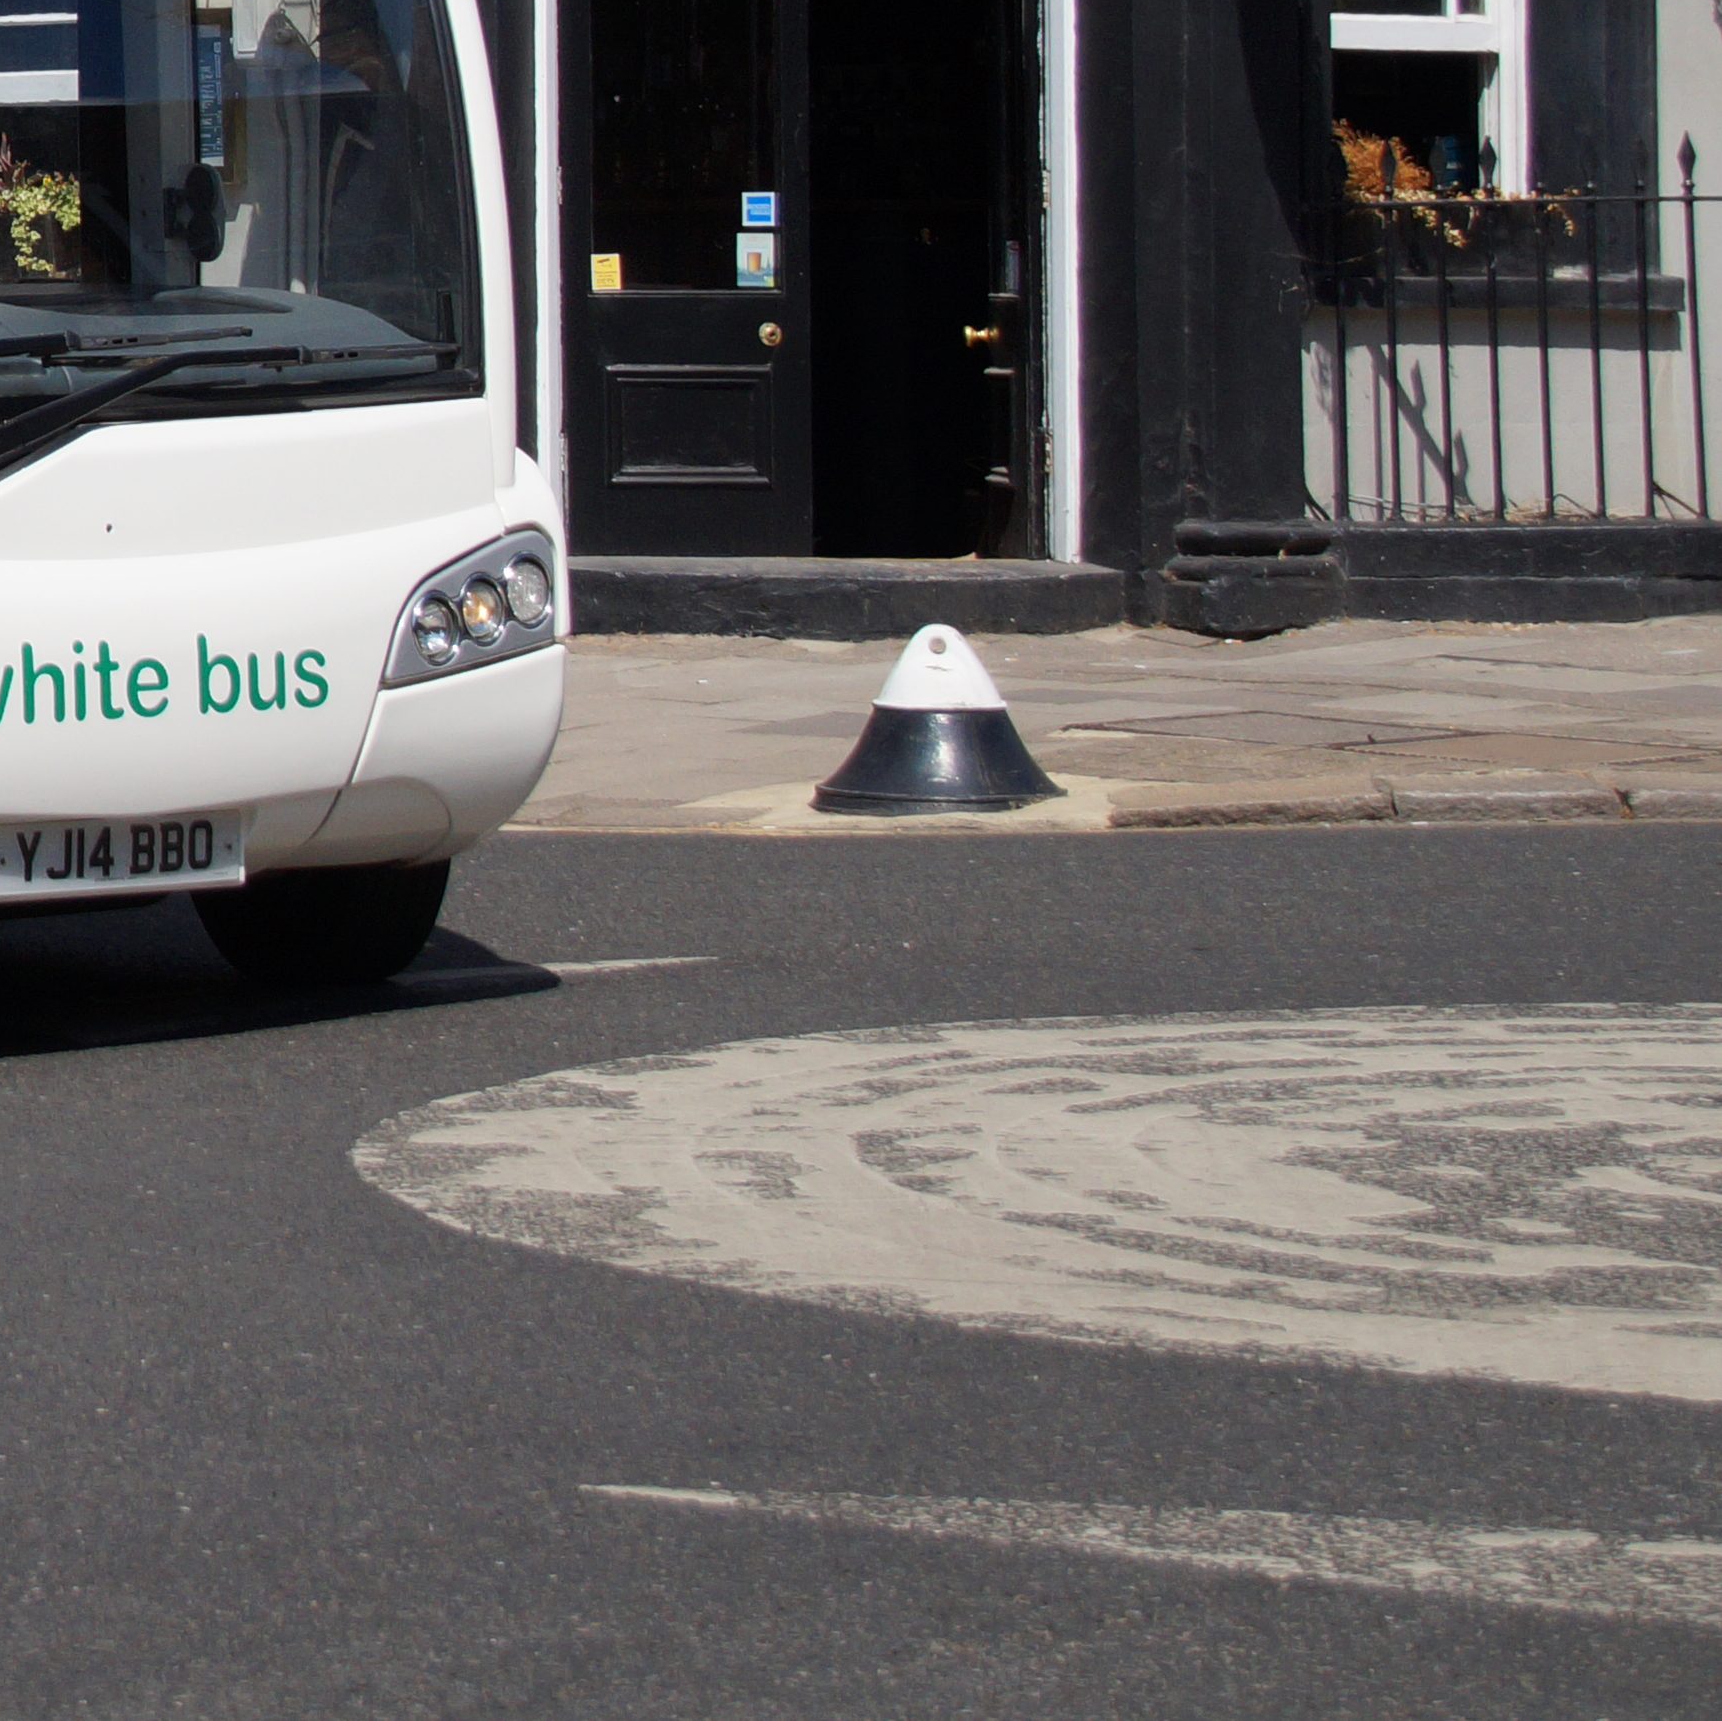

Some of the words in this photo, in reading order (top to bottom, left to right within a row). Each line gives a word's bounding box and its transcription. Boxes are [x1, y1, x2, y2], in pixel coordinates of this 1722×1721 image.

[196, 632, 330, 715] bus
[16, 825, 115, 882] YJ14
[129, 819, 214, 876] BBO
